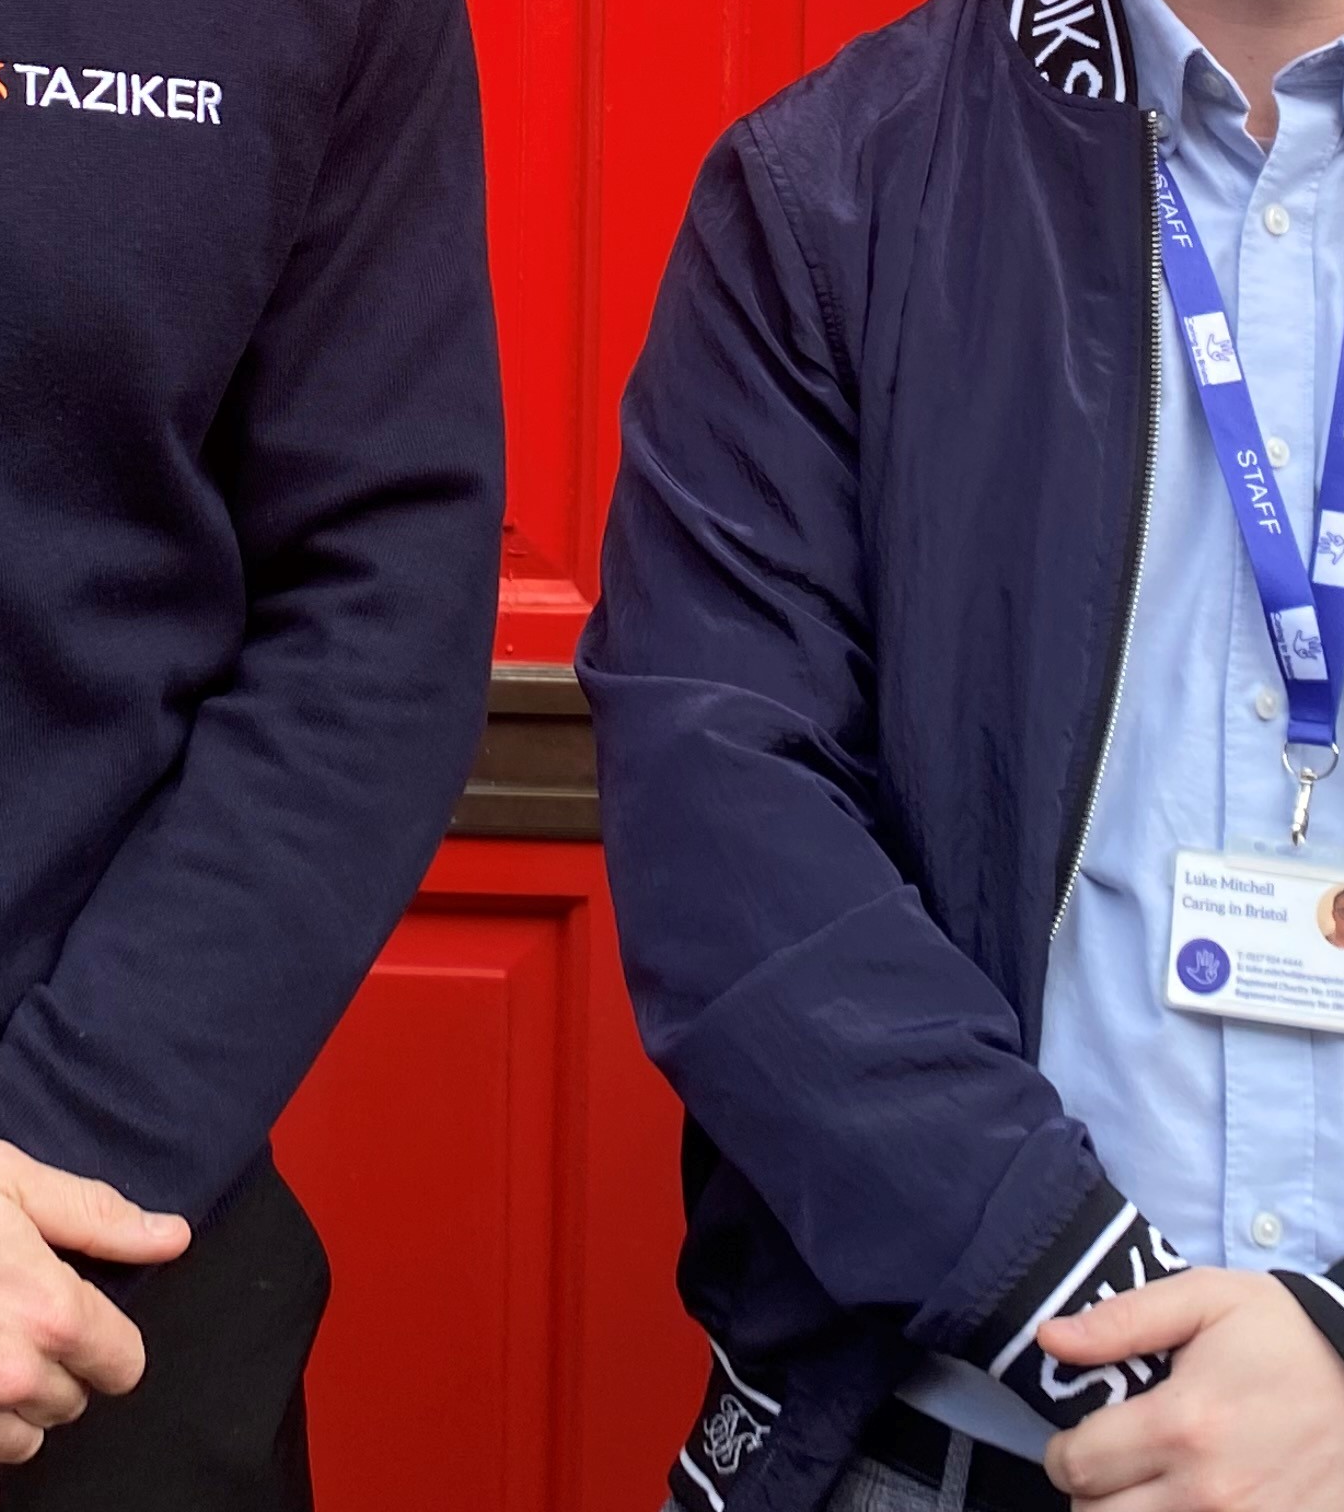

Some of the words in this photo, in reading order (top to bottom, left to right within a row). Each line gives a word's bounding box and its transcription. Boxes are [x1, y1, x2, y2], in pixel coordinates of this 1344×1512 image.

[12, 63, 224, 125] TAZIKER
[1157, 173, 1194, 248] STAFF
[1236, 449, 1282, 535] STAFF
[1182, 895, 1226, 916] Caring
[1229, 900, 1242, 916] in
[1245, 903, 1288, 923] Bristol
[1185, 870, 1217, 888] Luke
[1221, 876, 1275, 896] Mitchell
